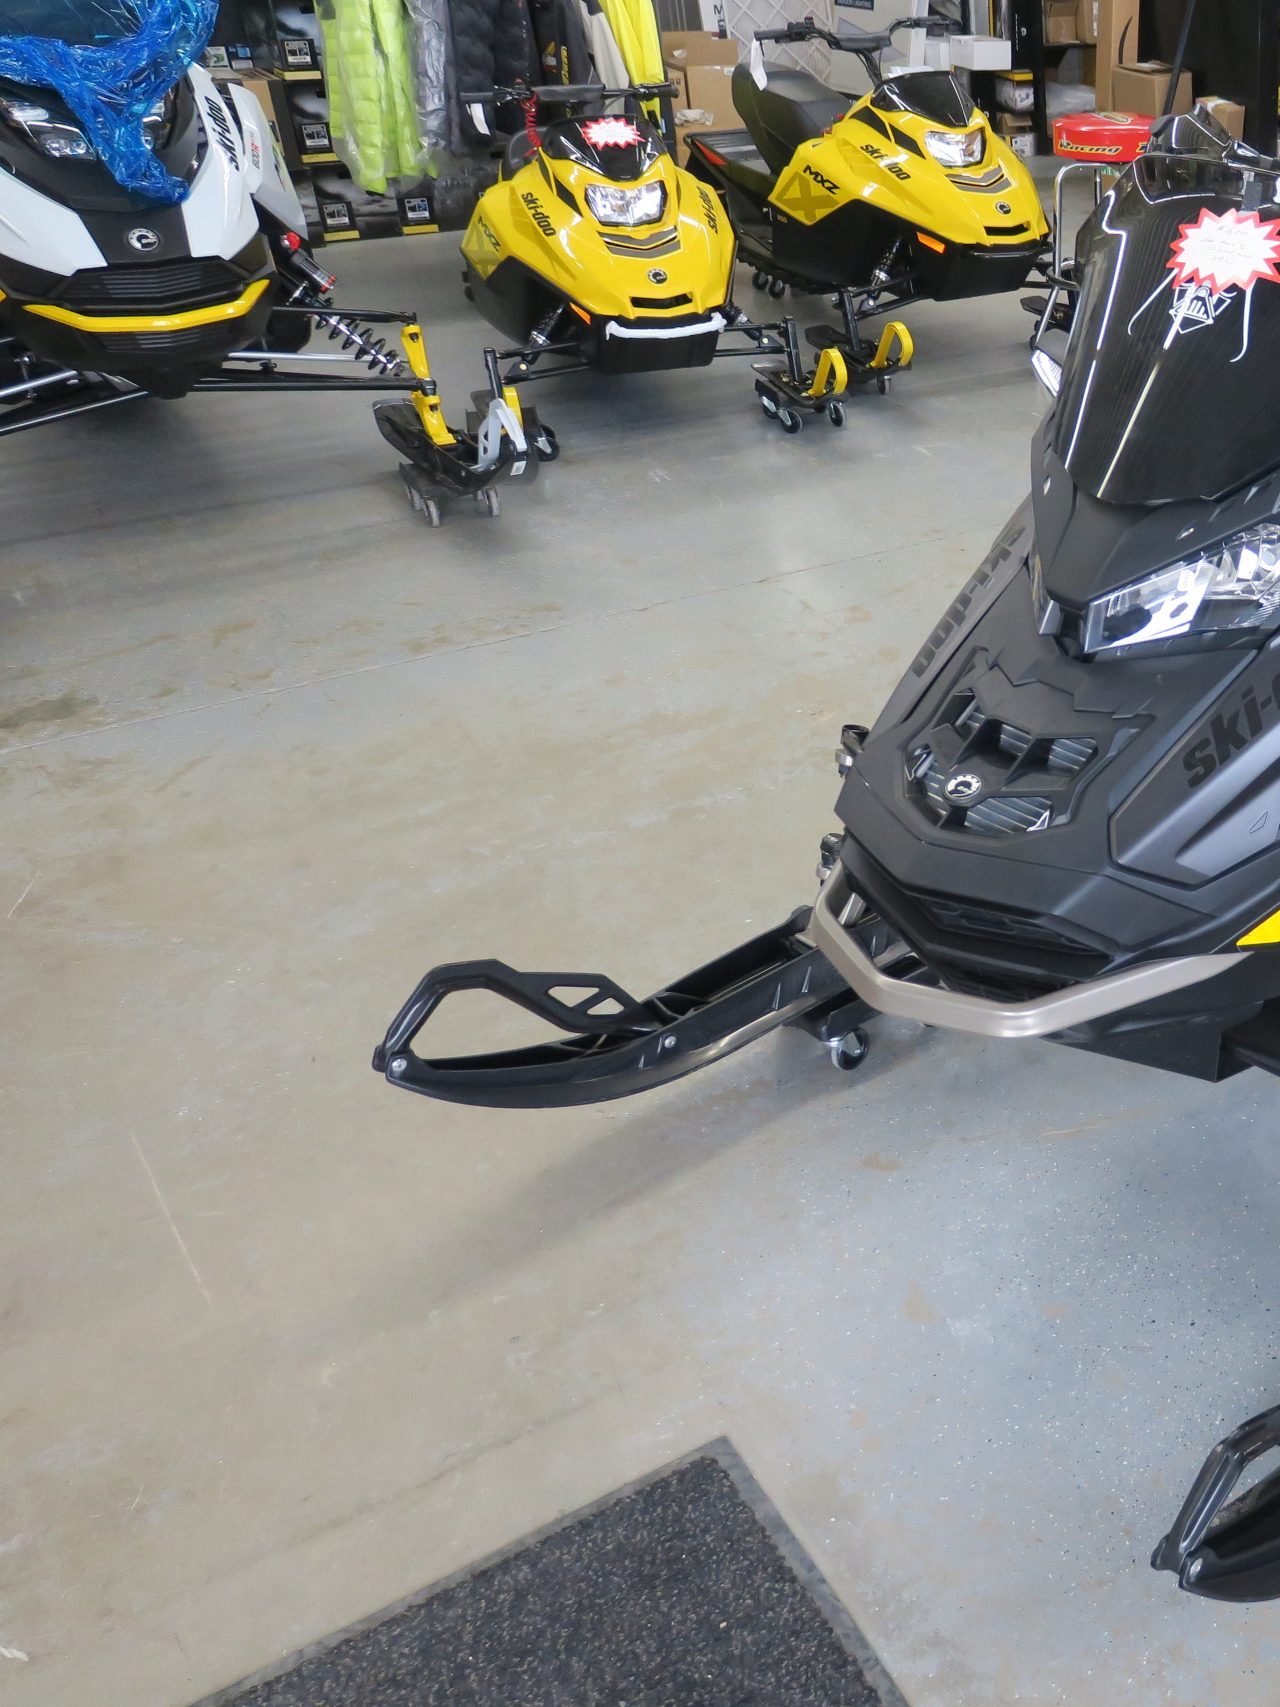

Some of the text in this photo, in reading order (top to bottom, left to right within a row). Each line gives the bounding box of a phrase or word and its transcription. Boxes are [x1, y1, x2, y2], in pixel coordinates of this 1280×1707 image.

[203, 95, 241, 172] ski-doo
[1058, 140, 1122, 155] Racing
[802, 164, 841, 195] MXZ
[521, 191, 558, 237] ski-doo
